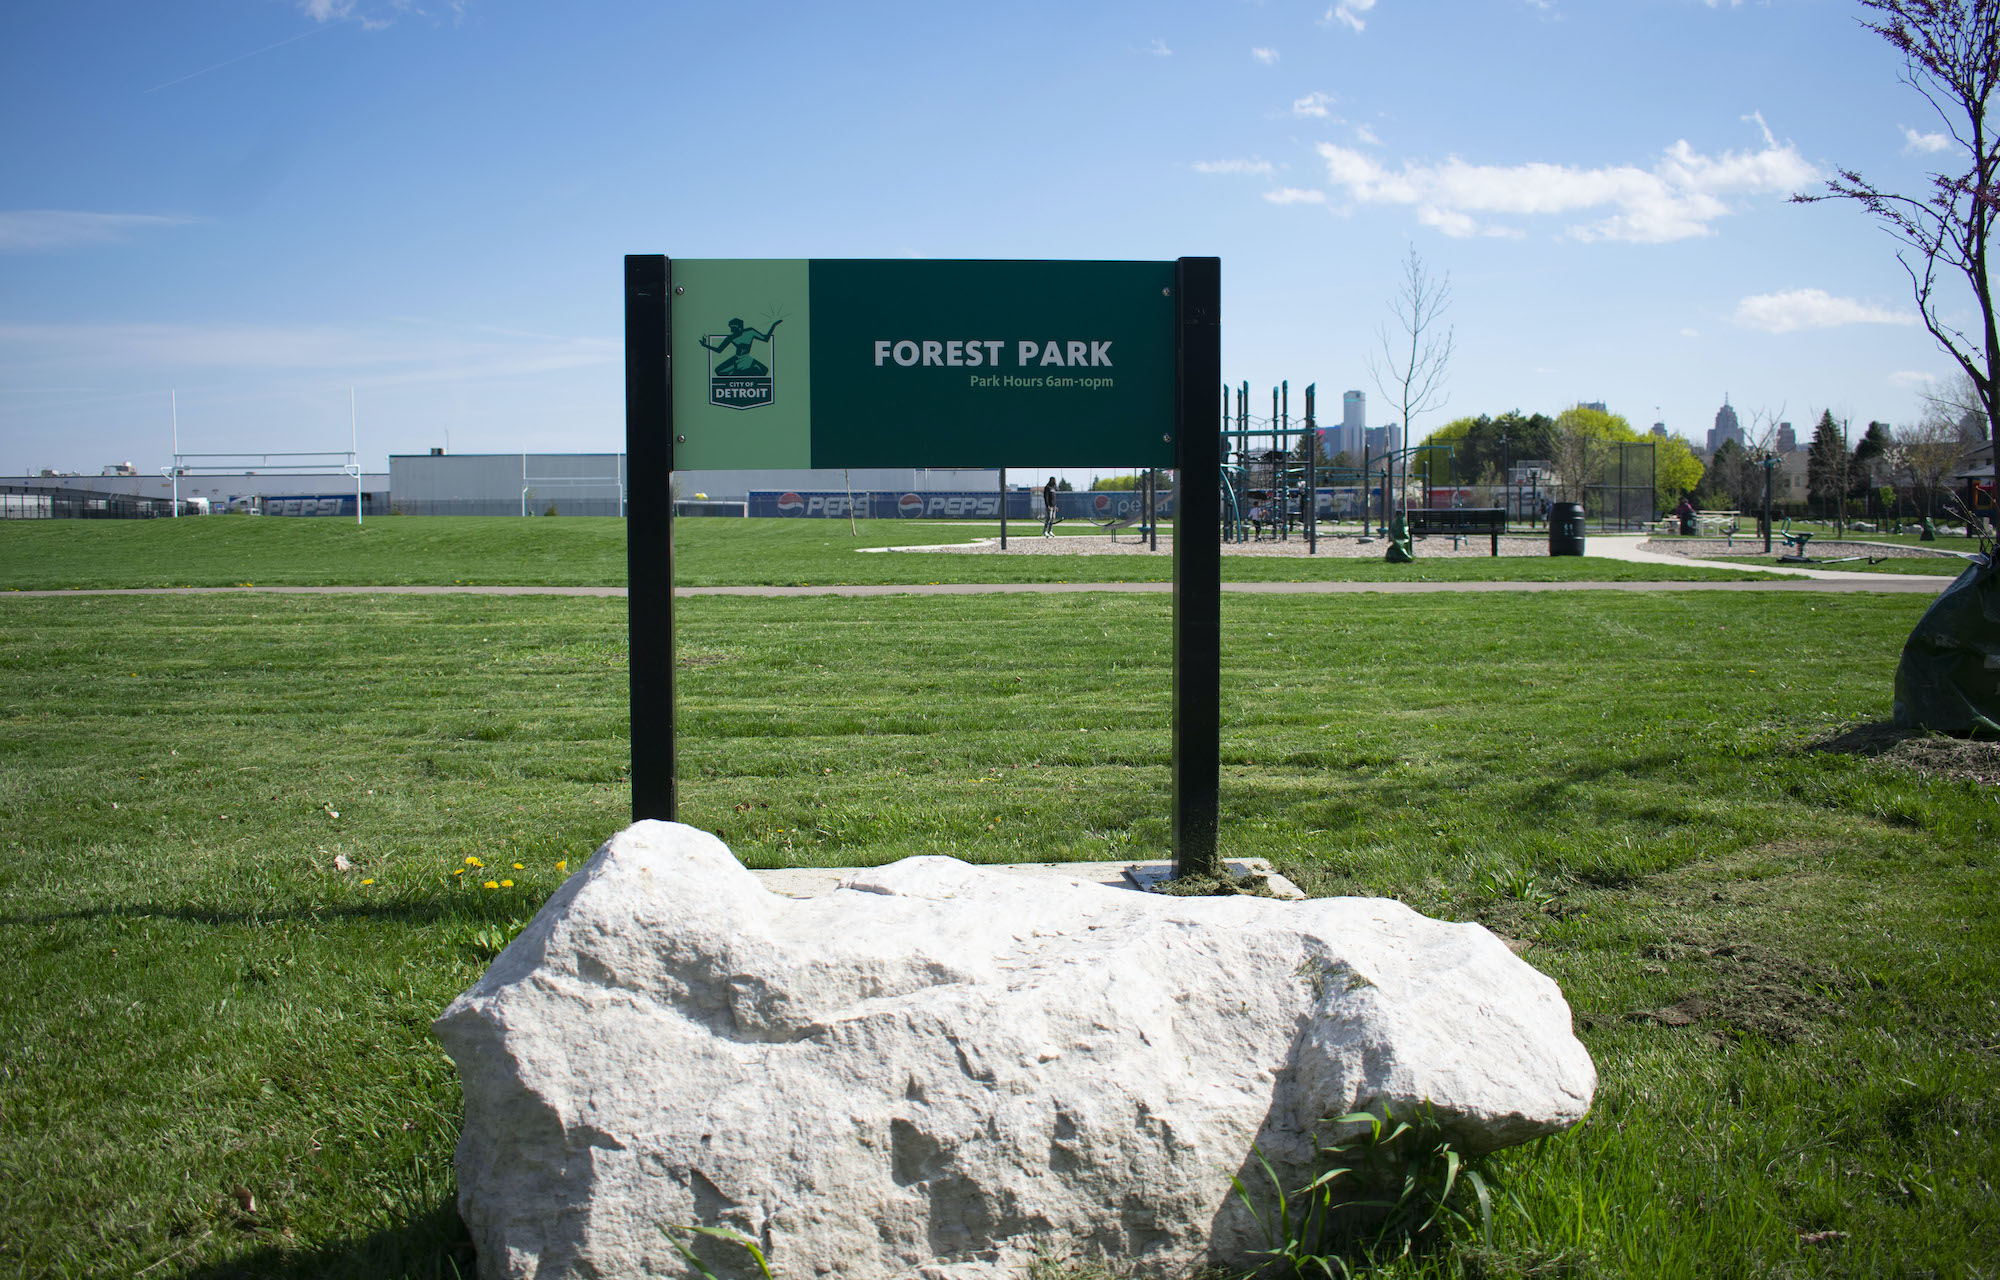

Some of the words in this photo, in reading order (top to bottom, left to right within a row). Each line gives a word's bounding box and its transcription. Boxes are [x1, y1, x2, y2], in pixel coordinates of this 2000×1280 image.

[874, 340, 1005, 367] FOREST
[1018, 340, 1114, 367] PARK
[970, 374, 1000, 387] Park
[1003, 375, 1043, 387] Hours
[1046, 375, 1114, 391] 6am-10pm
[715, 388, 768, 398] DETROIT
[266, 499, 343, 516] PEPSI
[926, 497, 1001, 515] PEPSI
